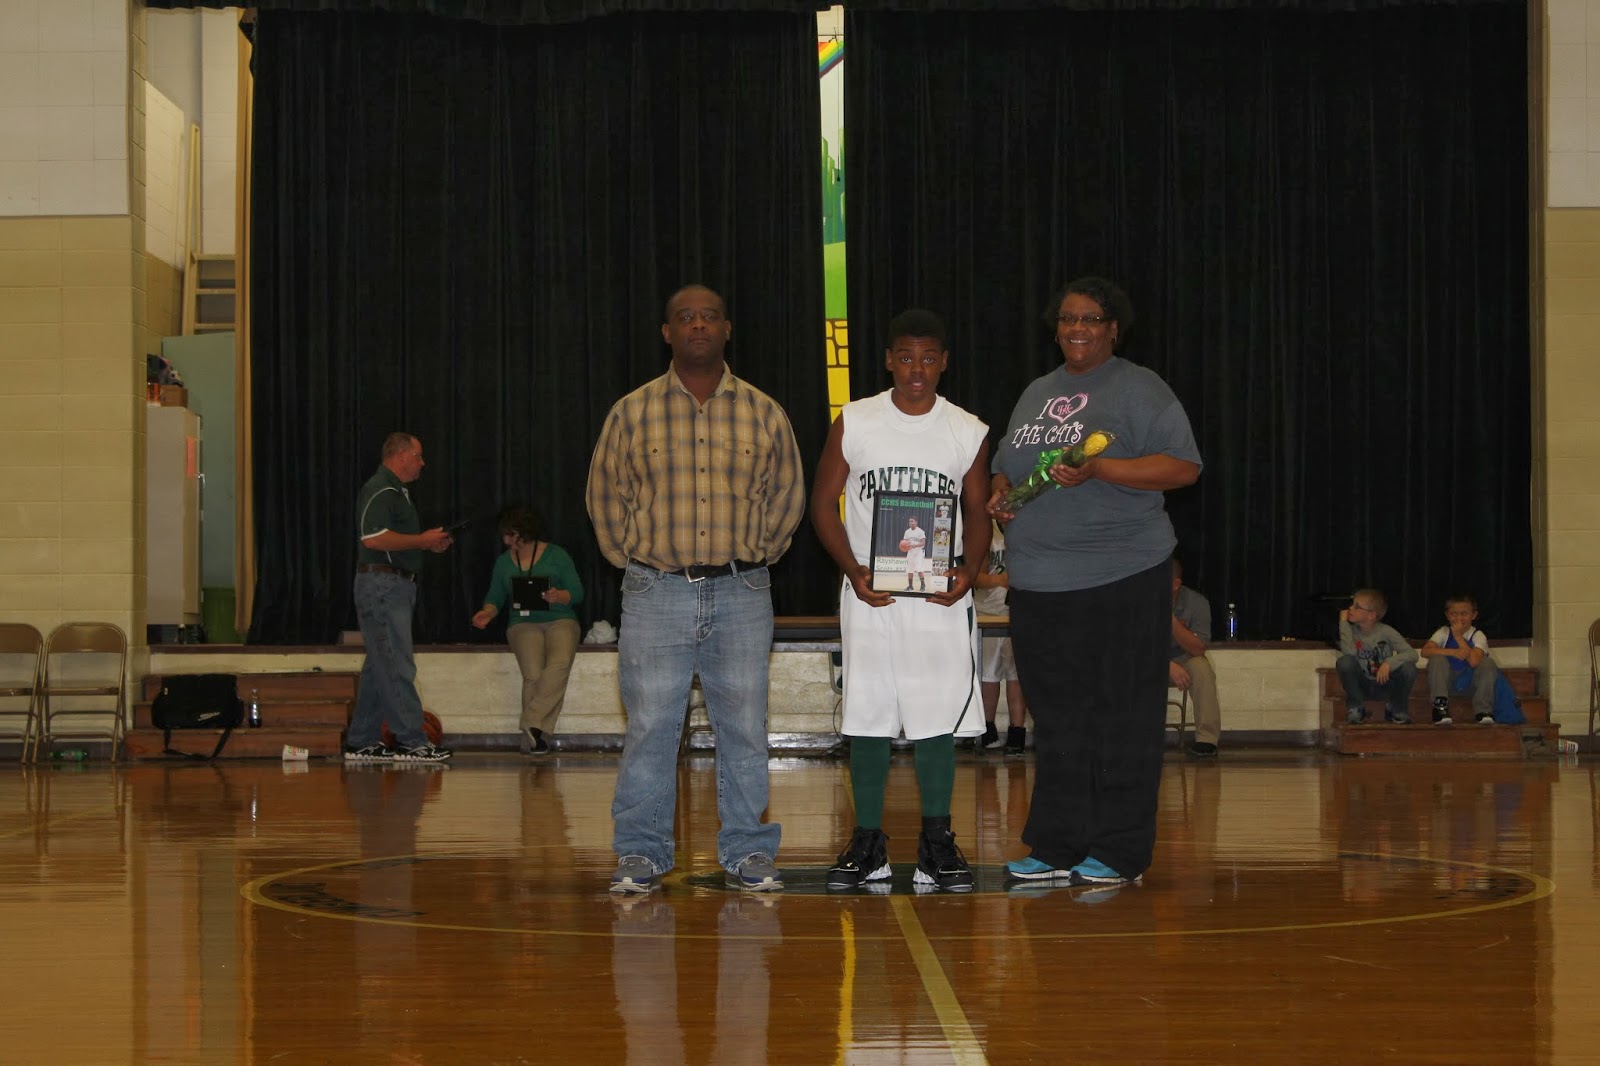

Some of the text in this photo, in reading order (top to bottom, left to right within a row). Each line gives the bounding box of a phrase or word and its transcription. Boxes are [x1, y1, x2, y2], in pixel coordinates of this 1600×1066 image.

[1036, 398, 1054, 419] I
[1012, 421, 1083, 448] THE CATS
[859, 466, 956, 502] PANTHERS
[900, 500, 934, 509] Basketball
